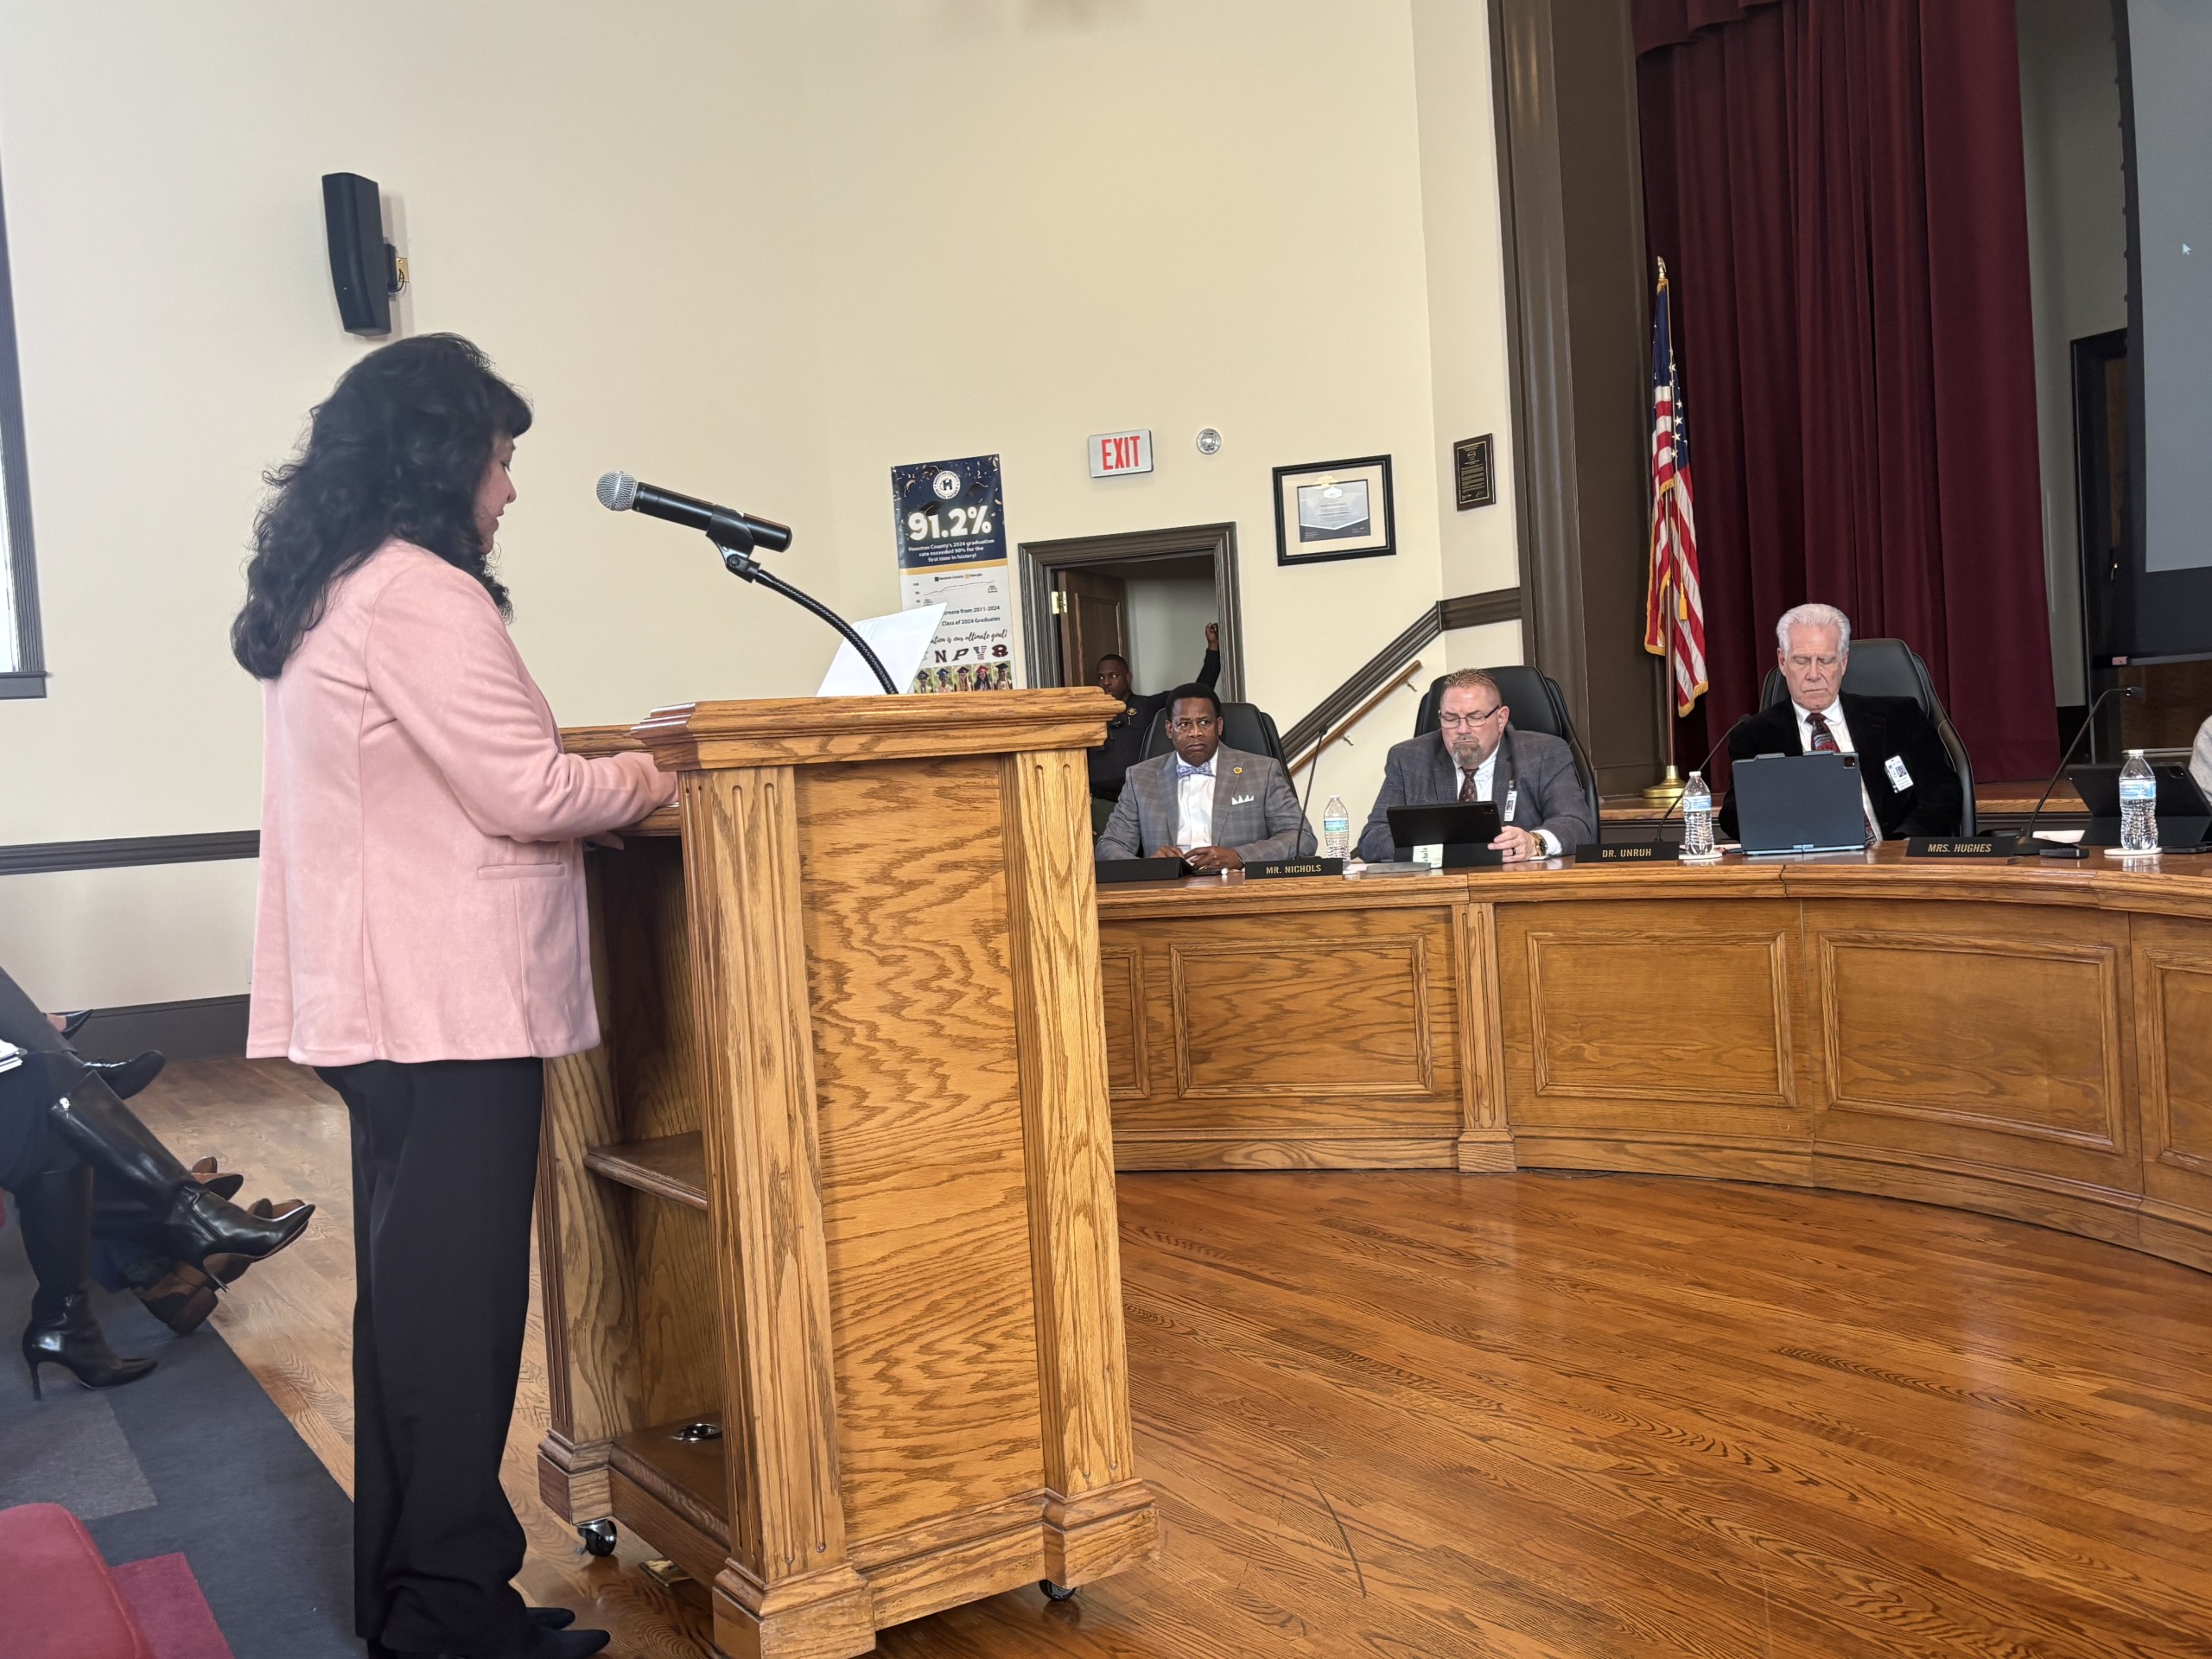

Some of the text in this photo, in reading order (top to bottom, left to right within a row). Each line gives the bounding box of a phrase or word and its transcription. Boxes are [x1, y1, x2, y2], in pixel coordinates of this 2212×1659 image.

[1102, 435, 1140, 470] EXIT
[908, 505, 992, 541] 91.2%
[935, 650, 948, 664] N
[951, 648, 969, 662] P
[1602, 849, 1652, 858] DR. UNRUH
[1928, 843, 1992, 853] MRS. HUGHES
